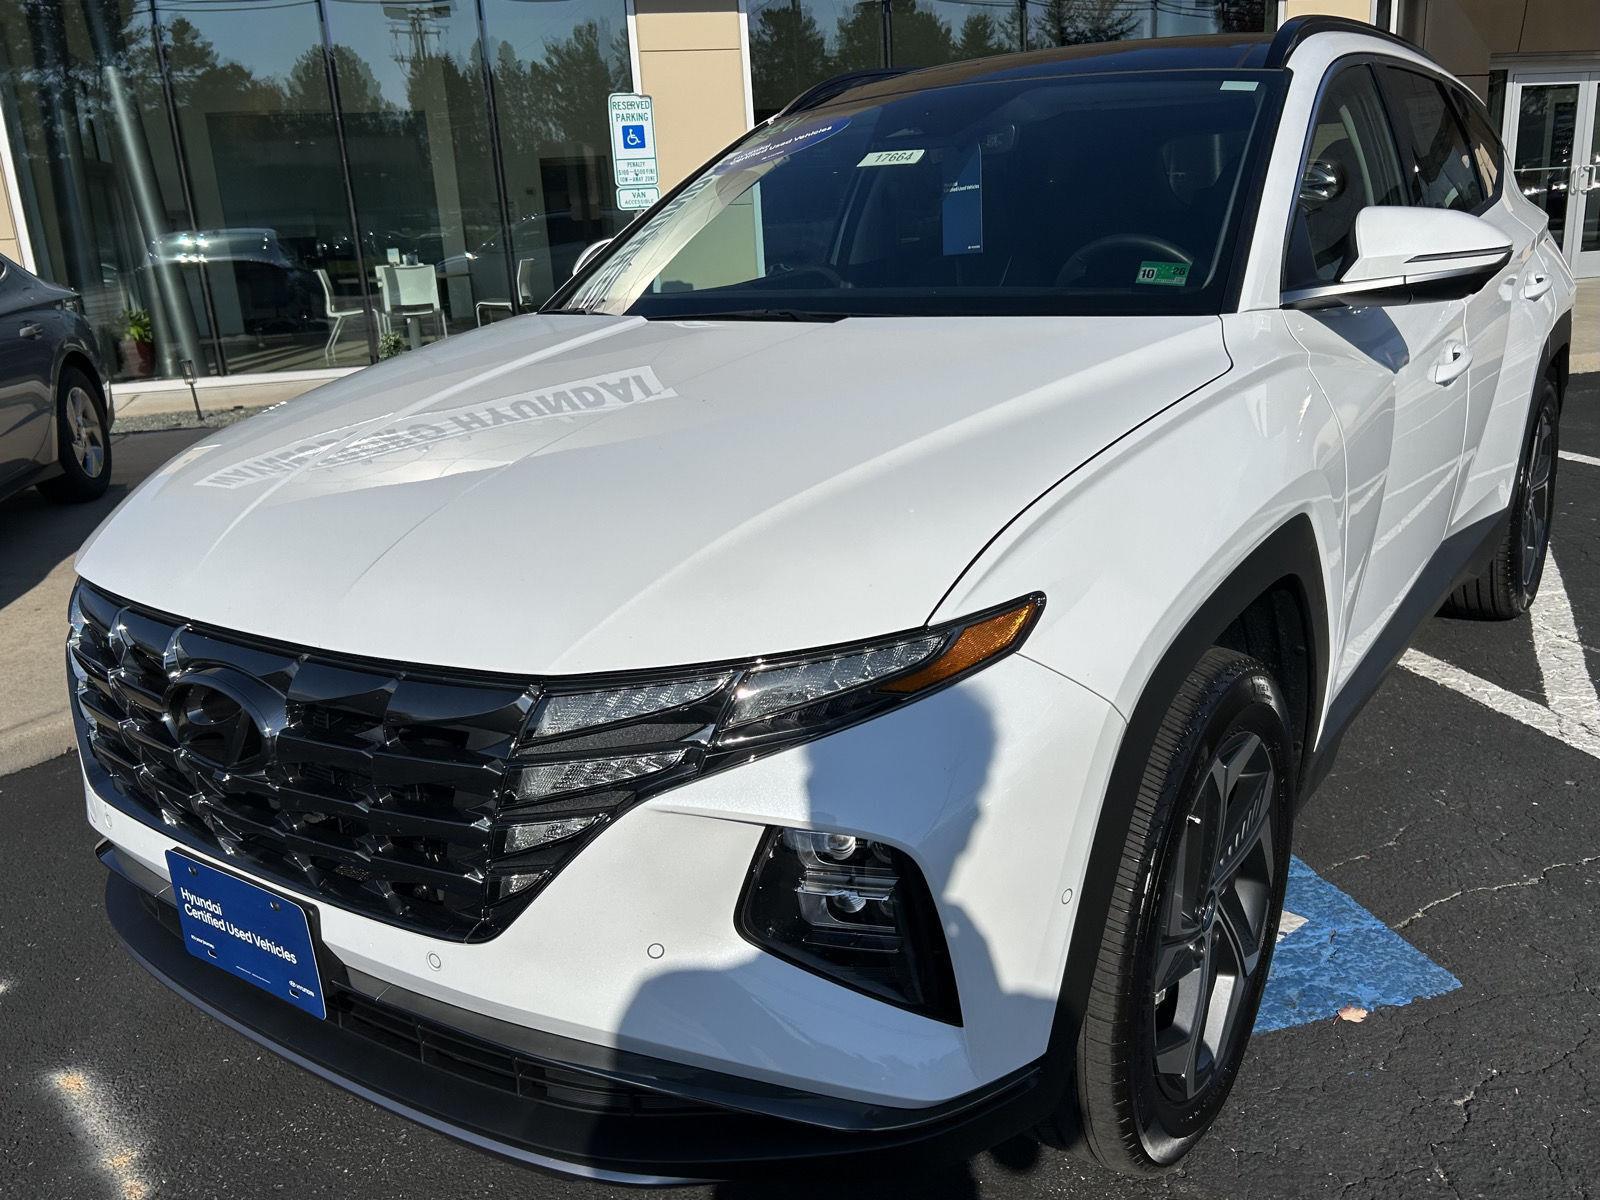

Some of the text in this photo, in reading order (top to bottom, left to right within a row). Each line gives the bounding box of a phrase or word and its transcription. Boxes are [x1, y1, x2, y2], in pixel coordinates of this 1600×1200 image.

[612, 100, 650, 110] RESERVED
[615, 112, 649, 122] PARKING
[874, 152, 914, 162] 17664
[1141, 268, 1155, 279] 10
[180, 886, 223, 916] Hyundai
[184, 903, 227, 932] Certified
[225, 921, 254, 944] Used
[252, 933, 297, 965] Vehicles
